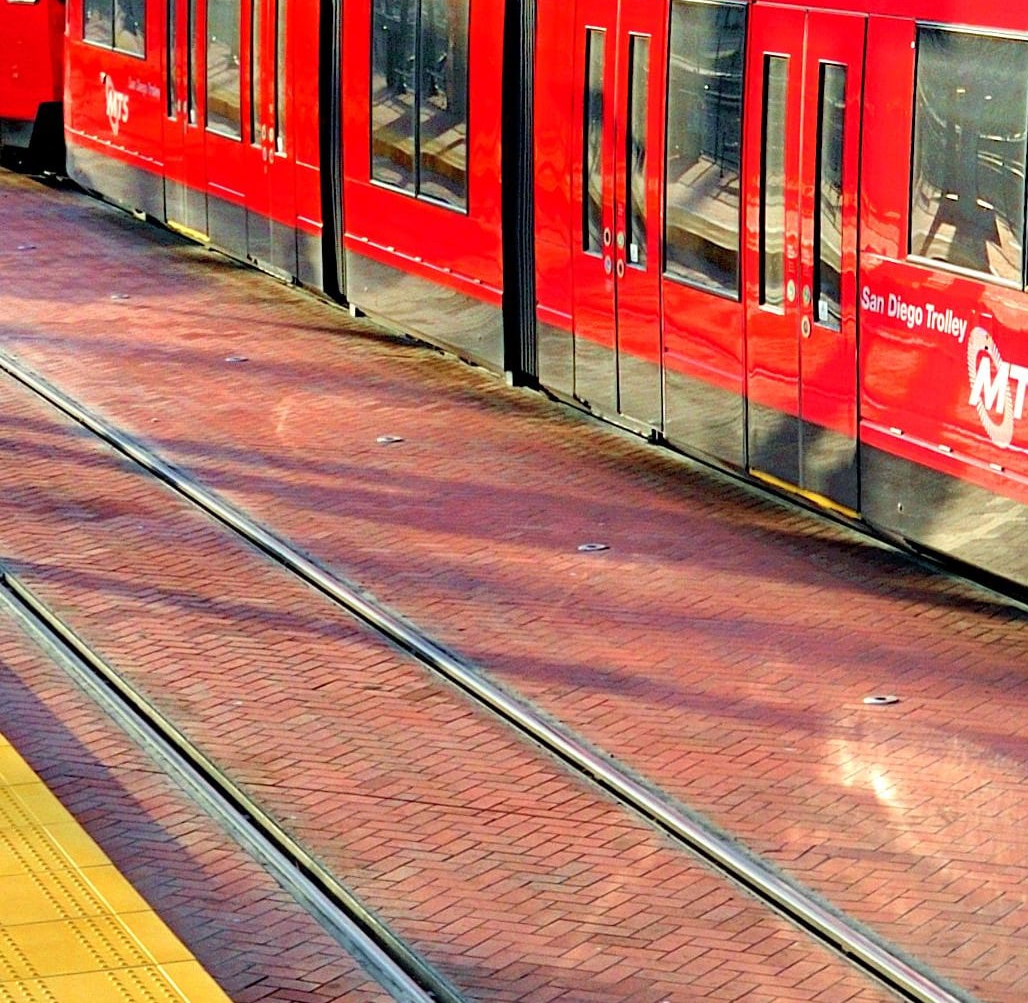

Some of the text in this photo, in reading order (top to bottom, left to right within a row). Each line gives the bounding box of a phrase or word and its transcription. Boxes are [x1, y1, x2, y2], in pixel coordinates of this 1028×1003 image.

[861, 286, 968, 344] San Diego Trolley
